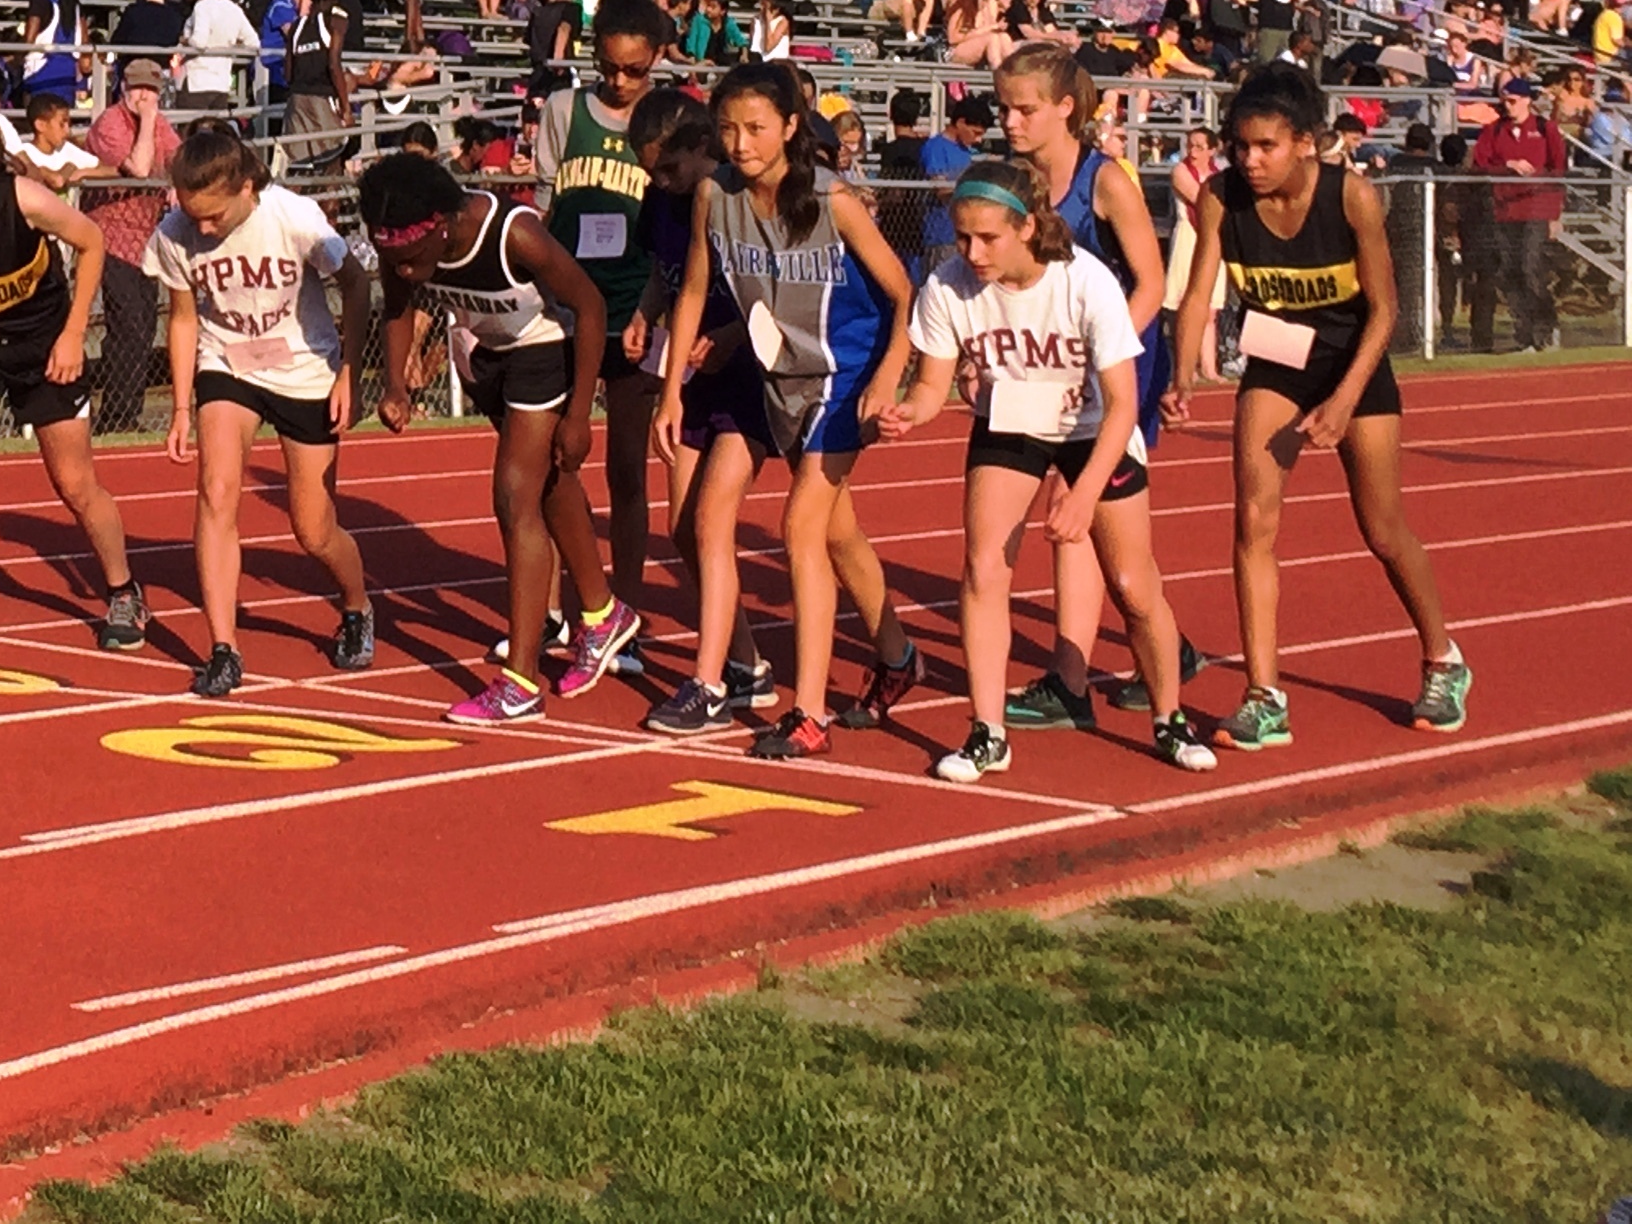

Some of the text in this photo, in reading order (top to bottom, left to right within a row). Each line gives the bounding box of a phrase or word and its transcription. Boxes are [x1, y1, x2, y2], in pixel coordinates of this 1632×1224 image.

[190, 255, 299, 294] HPMS
[963, 328, 1088, 370] HPMS
[100, 715, 464, 770] 2
[543, 779, 865, 841] 1
